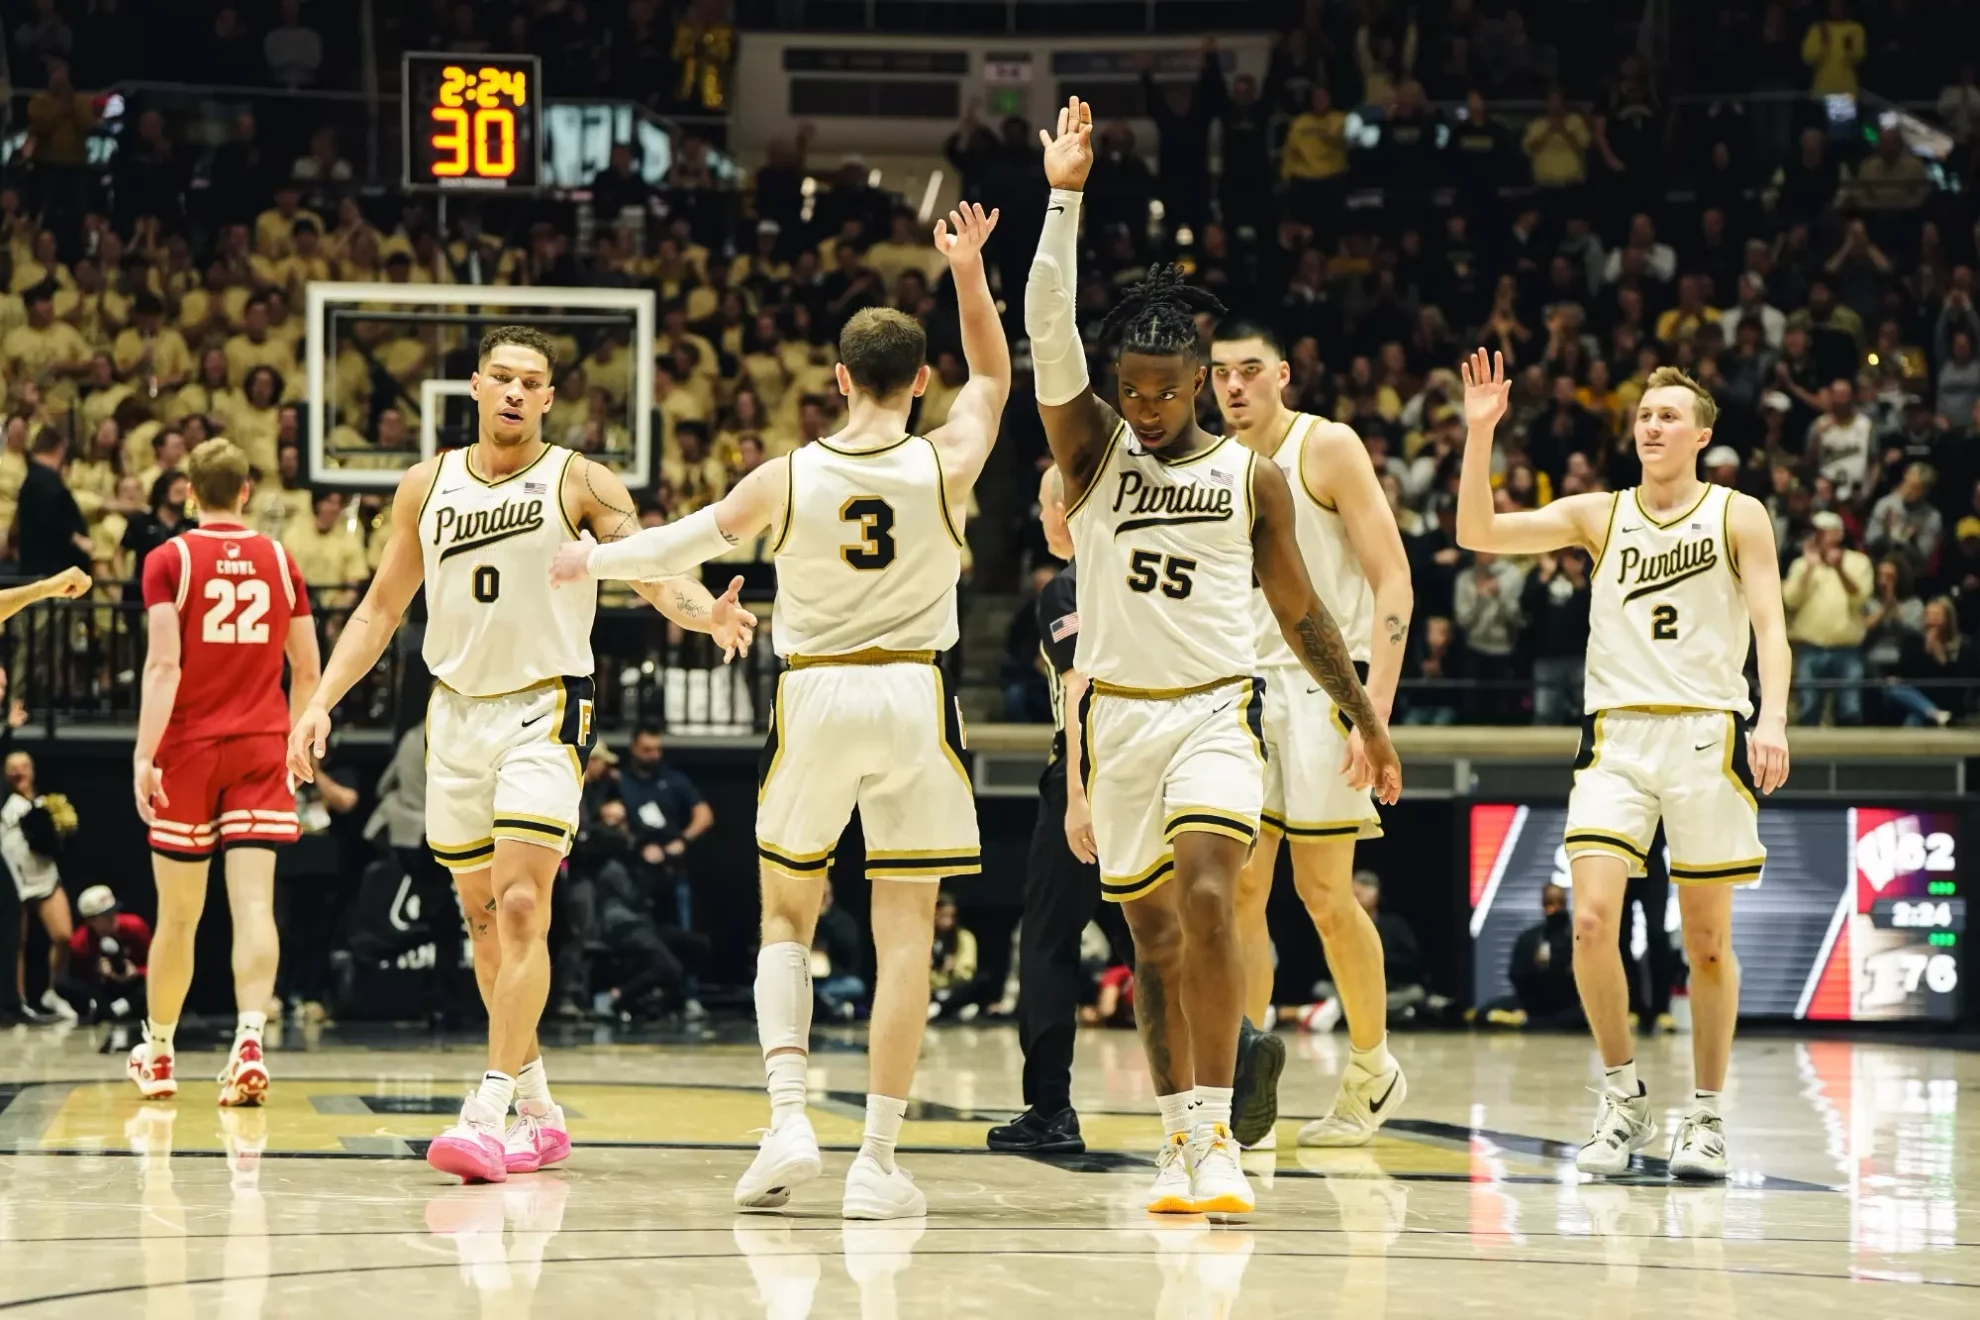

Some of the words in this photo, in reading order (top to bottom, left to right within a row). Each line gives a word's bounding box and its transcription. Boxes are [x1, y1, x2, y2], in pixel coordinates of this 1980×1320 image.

[440, 66, 526, 107] 2:24
[431, 107, 515, 177] 30
[1112, 470, 1234, 515] Purdue
[433, 498, 544, 546] Purdue
[839, 495, 897, 571] 3
[472, 564, 500, 603] 0
[1126, 548, 1197, 599] 55
[1617, 537, 1717, 585] Purdue
[202, 578, 271, 644] 22
[1651, 604, 1678, 640] 2
[1892, 901, 1952, 927] 2:24
[1895, 953, 1958, 993] 76
